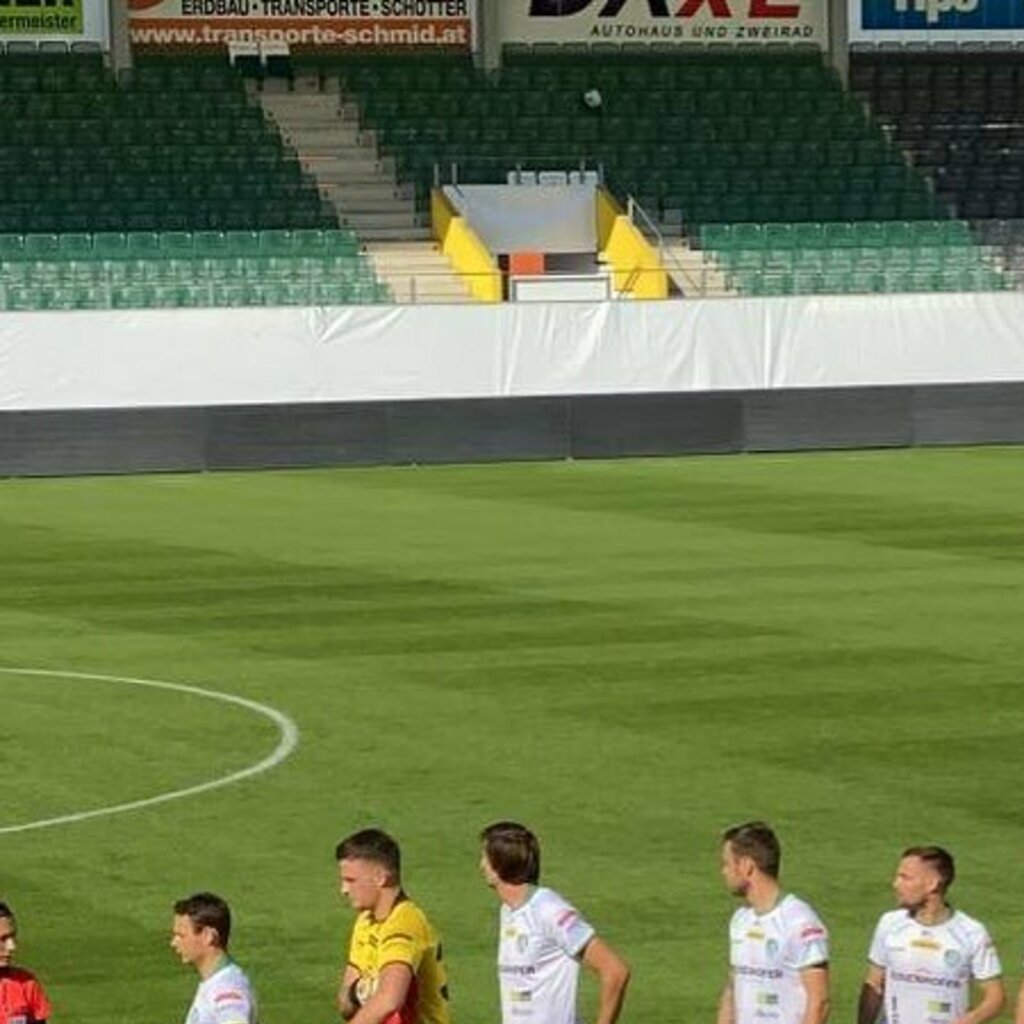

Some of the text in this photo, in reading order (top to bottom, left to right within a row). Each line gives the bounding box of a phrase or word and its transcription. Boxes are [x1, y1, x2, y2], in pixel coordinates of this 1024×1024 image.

[131, 24, 466, 45] www.transporte-schmid.at
[591, 25, 814, 37] AUTOHAUS UND ZWEIRAD
